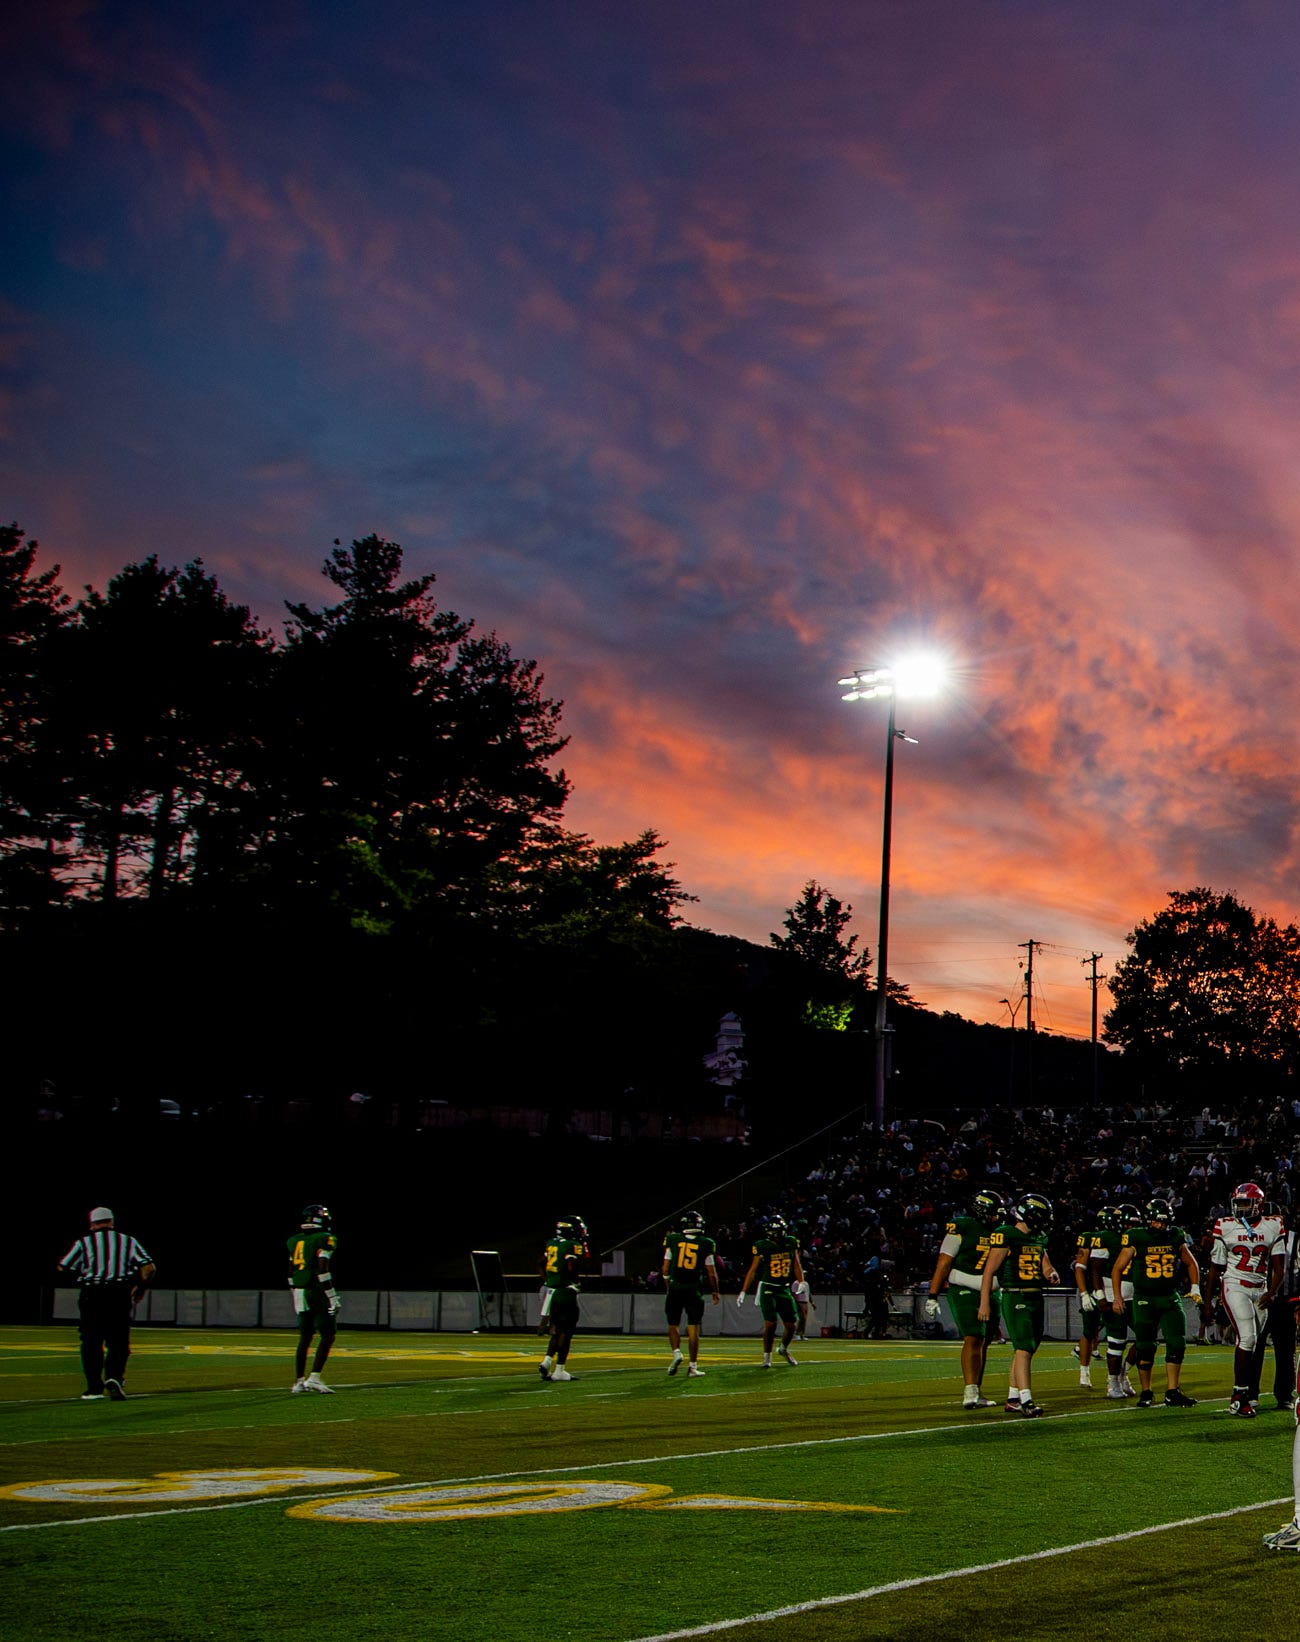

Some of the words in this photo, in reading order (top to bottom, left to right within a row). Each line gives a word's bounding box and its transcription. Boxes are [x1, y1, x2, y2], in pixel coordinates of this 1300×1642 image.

[292, 1240, 306, 1271] 4
[677, 1241, 700, 1270] 15
[975, 1244, 991, 1270] 7
[1232, 1244, 1269, 1274] 22
